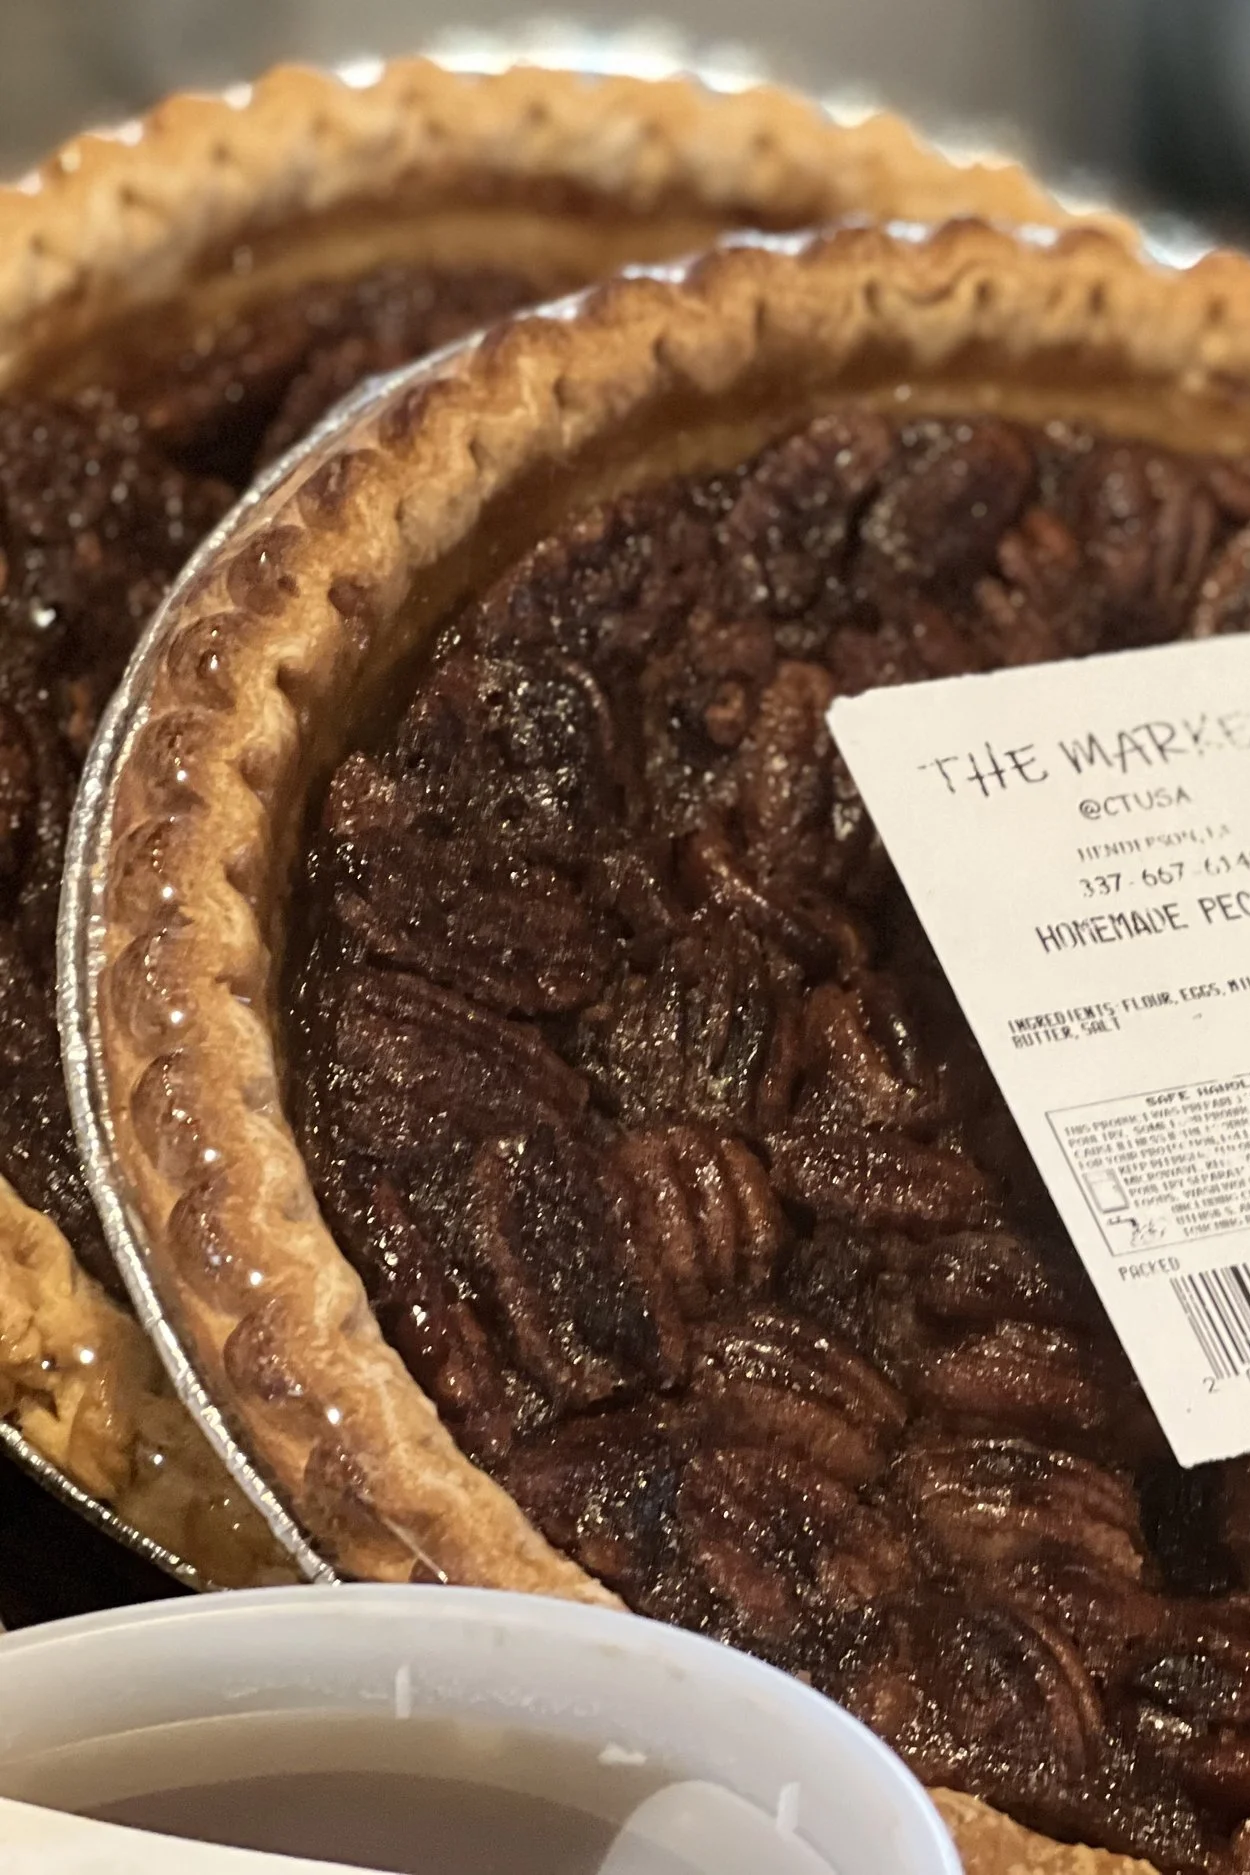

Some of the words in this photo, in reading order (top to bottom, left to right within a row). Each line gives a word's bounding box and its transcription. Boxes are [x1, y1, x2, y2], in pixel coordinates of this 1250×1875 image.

[917, 741, 1049, 798] THE
[1078, 786, 1192, 820] @CTUSA
[1035, 903, 1189, 953] HOMEMADE
[1080, 1016, 1121, 1036] SALT
[1118, 1257, 1181, 1281] PACKED
[1202, 1376, 1220, 1394] 2
